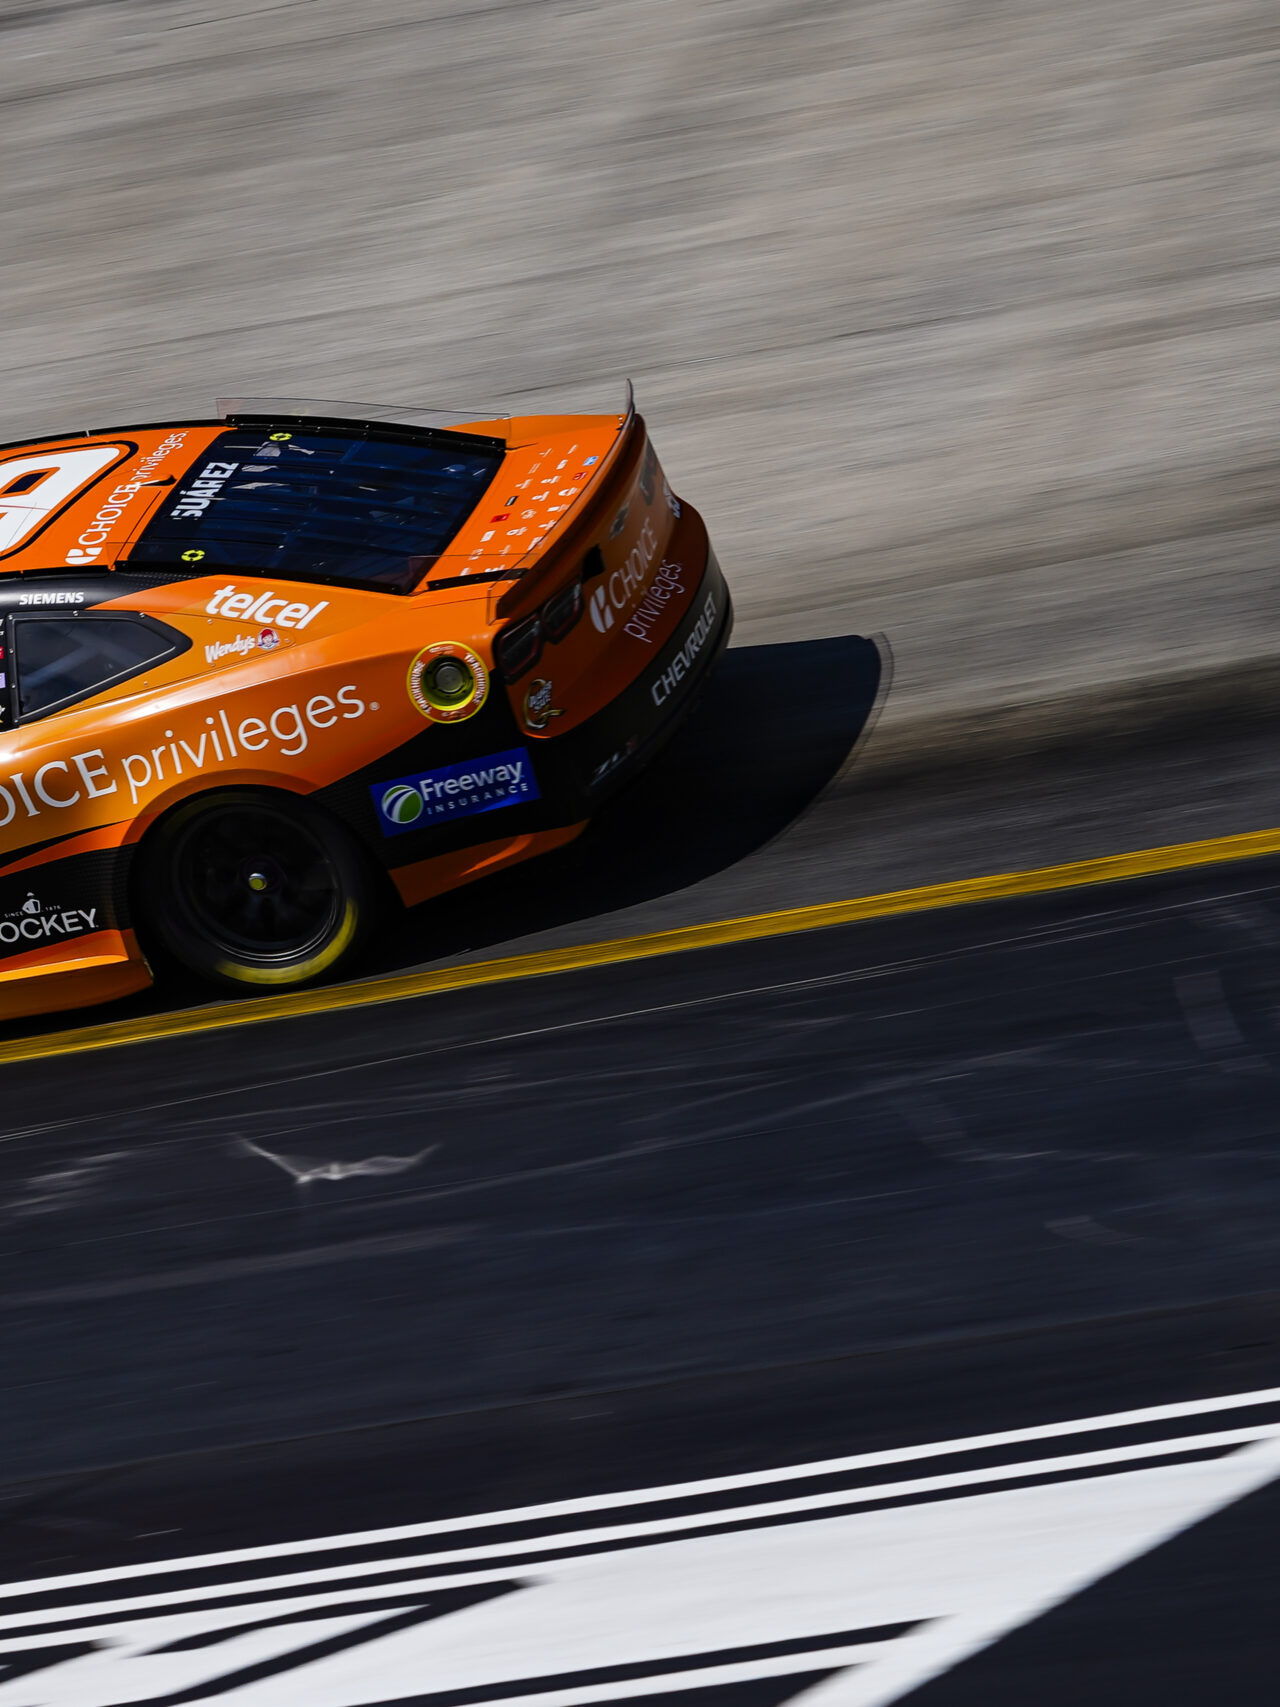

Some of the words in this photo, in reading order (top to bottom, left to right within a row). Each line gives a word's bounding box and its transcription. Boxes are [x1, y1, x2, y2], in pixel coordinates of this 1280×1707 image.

[170, 462, 240, 520] SUÁREZ
[78, 484, 141, 546] CHOICE
[609, 516, 658, 609] CHOICE
[19, 592, 84, 605] SIEMENS
[205, 585, 330, 629] telcel
[204, 634, 256, 664] Wendy's
[650, 591, 717, 706] CHEVROLET
[419, 761, 523, 801] Freeway
[427, 783, 529, 815] INSURANCE
